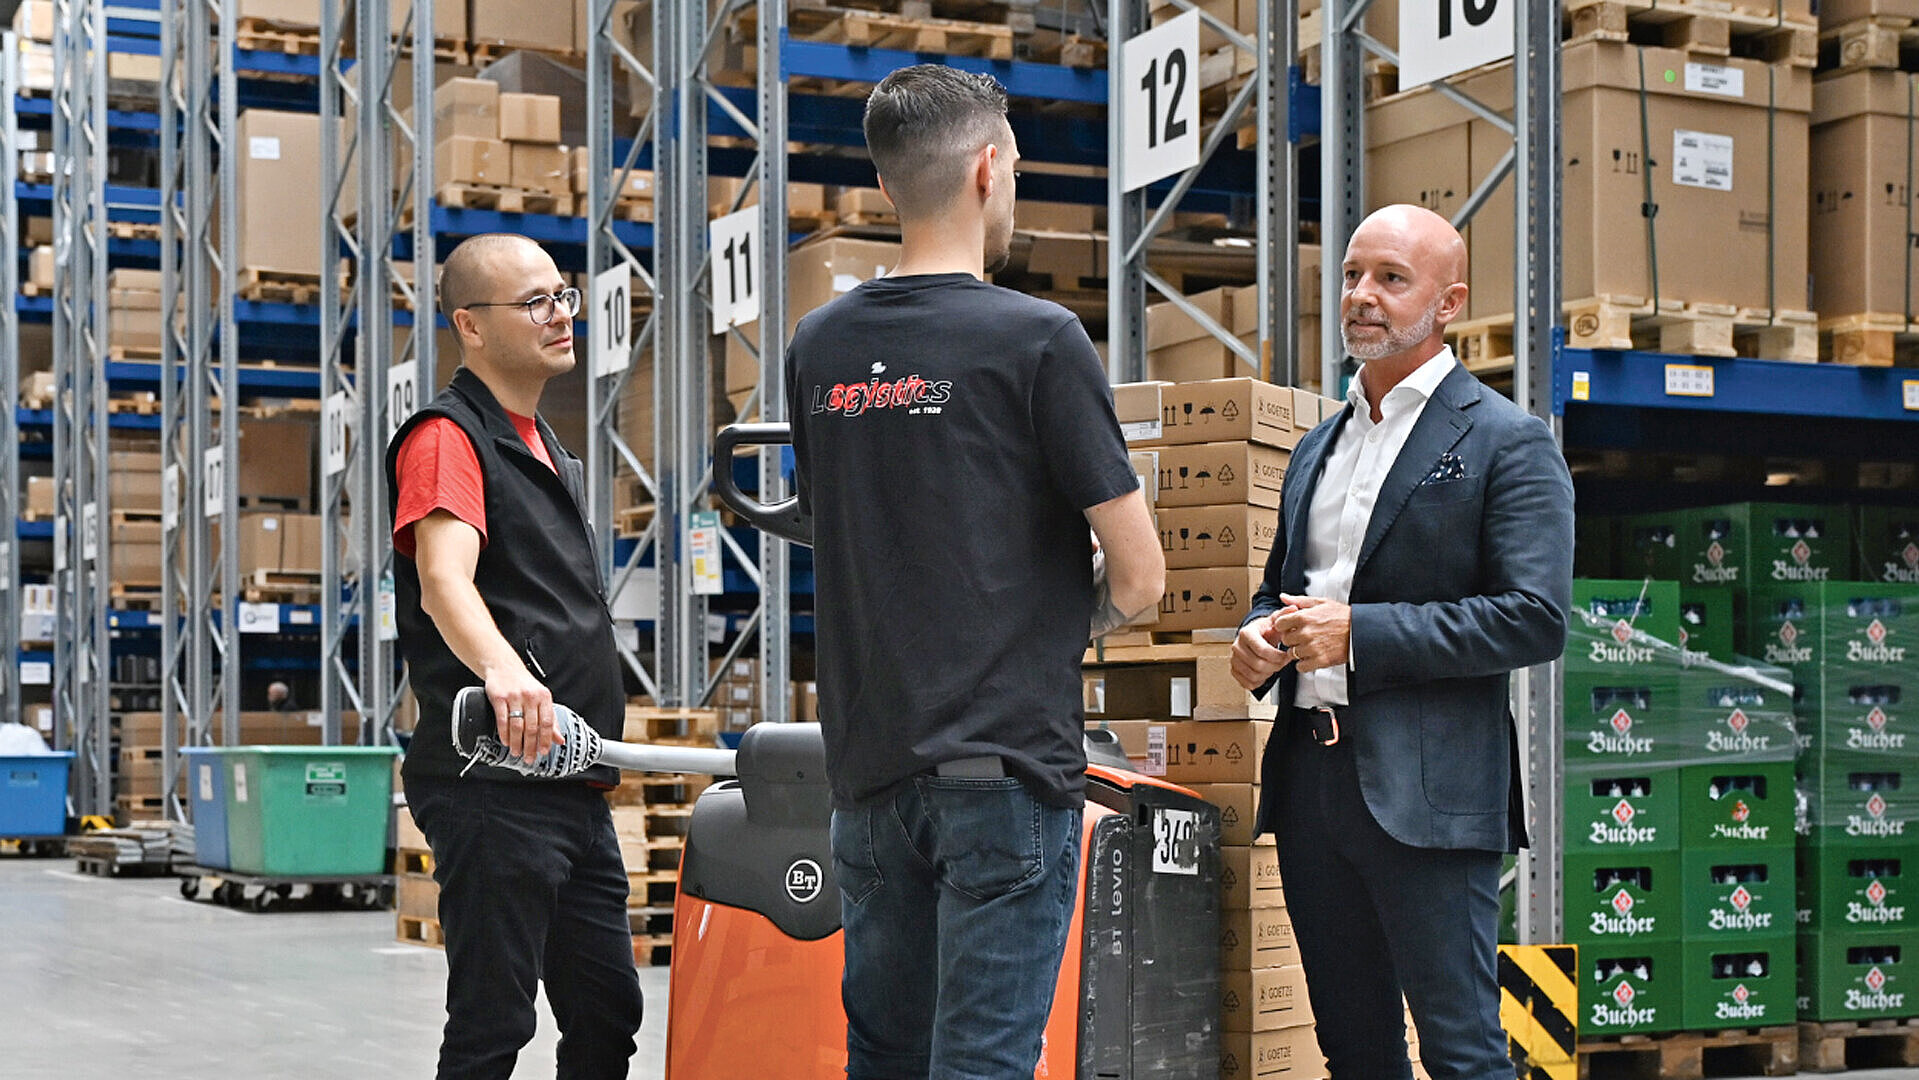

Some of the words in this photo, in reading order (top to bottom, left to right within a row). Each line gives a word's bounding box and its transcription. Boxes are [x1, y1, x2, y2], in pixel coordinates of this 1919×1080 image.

[1141, 47, 1187, 149] 12
[724, 232, 752, 304] 11
[604, 285, 625, 350] 10
[811, 374, 953, 417] Logistics
[1267, 402, 1290, 420] GOETZE
[1263, 464, 1284, 480] GOETZ
[1693, 563, 1738, 583] Bucher
[1771, 559, 1829, 581] Bucher
[1588, 641, 1654, 664] Bucher
[1764, 643, 1812, 663] Bucher
[1846, 640, 1906, 662] Bucher
[1588, 731, 1654, 755] Bucher
[1705, 730, 1769, 754] Bucher
[1846, 728, 1905, 750] Bucher
[1589, 822, 1656, 846] Bucher
[1845, 815, 1904, 837] Bucher
[792, 870, 816, 889] BT
[1589, 912, 1655, 936] Bucher
[1708, 908, 1772, 932] Bucher
[1845, 902, 1904, 925] Bucher
[1112, 926, 1123, 955] BT
[1266, 924, 1291, 936] GOETZE
[1268, 986, 1293, 1000] GOETZE
[1844, 989, 1903, 1012] Bucher
[1591, 1003, 1655, 1028] Bucher
[1715, 1001, 1765, 1020] Bucher
[1266, 1046, 1292, 1061] GOETZE
